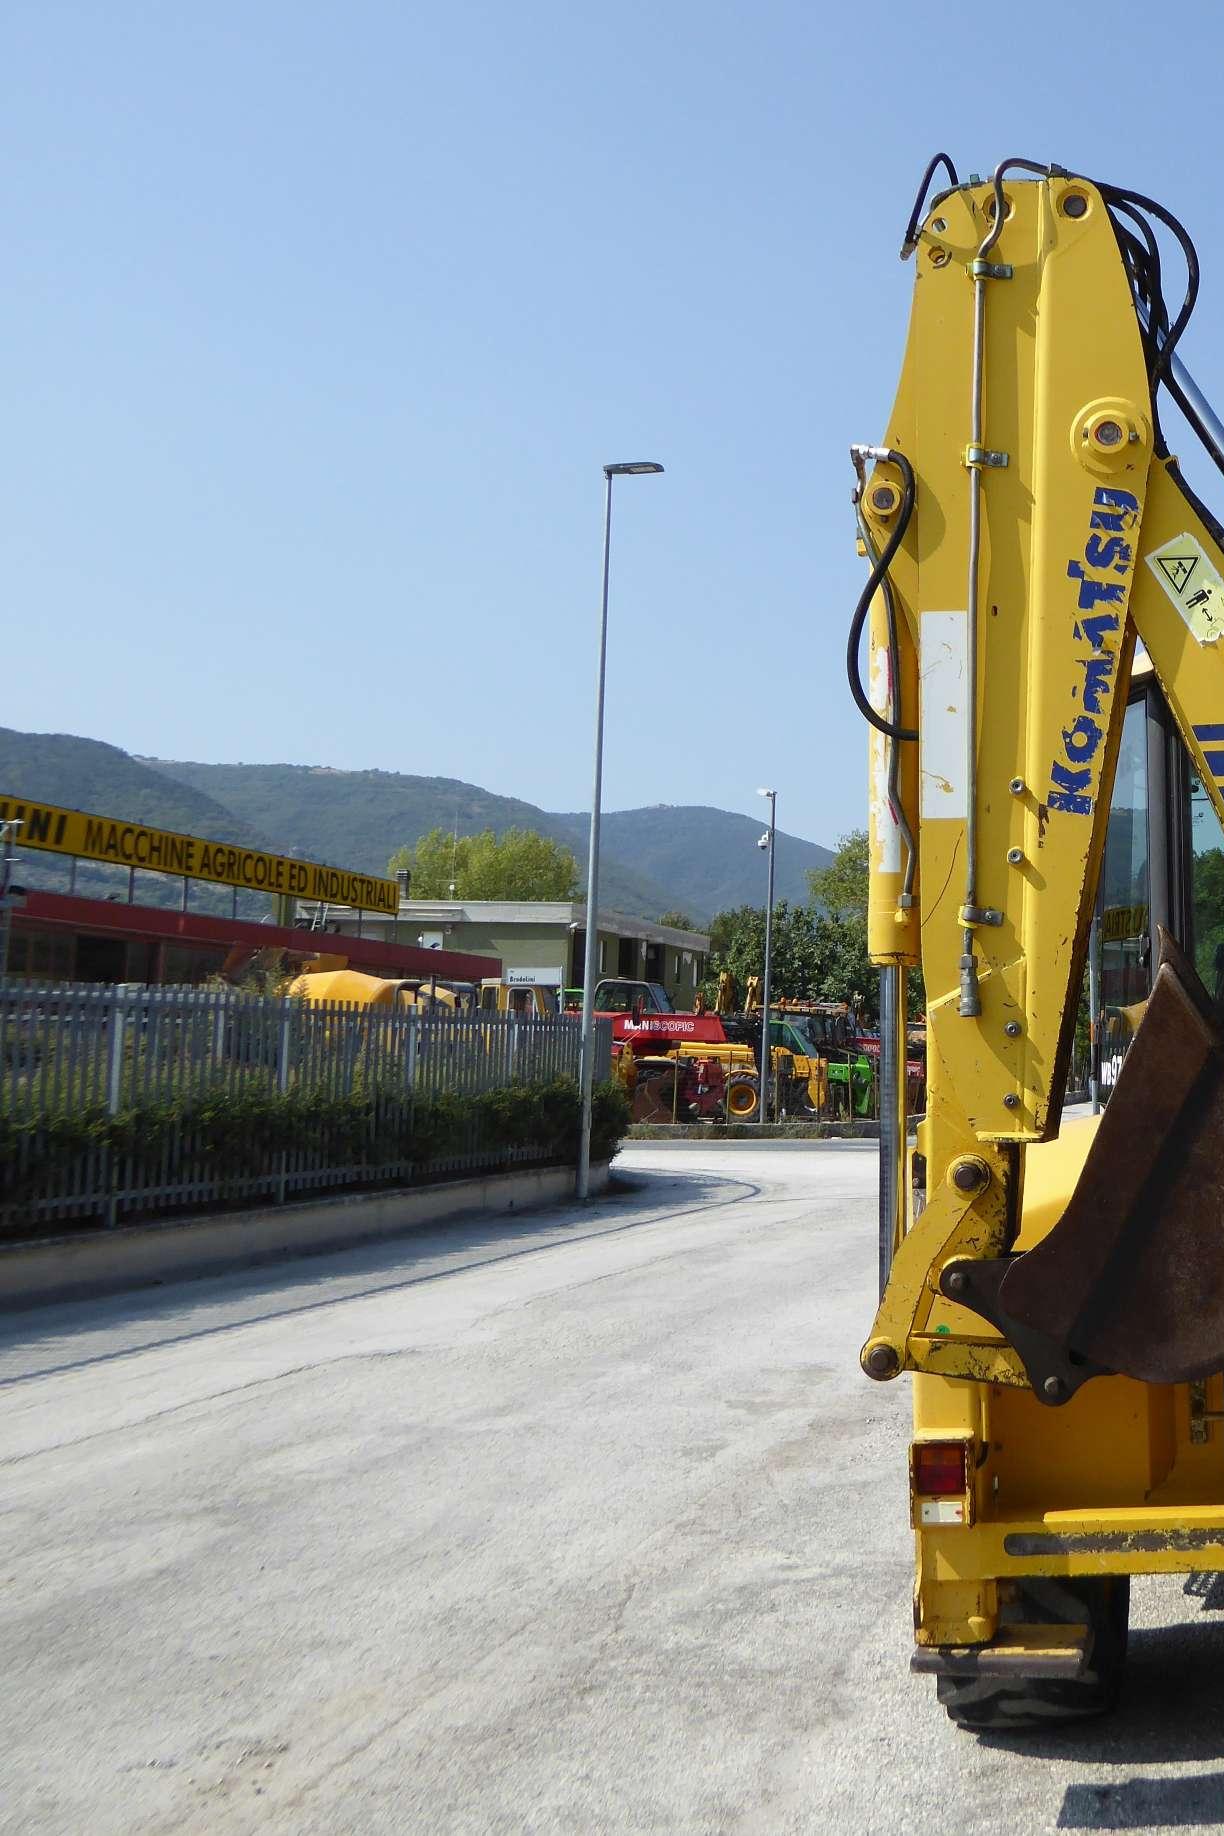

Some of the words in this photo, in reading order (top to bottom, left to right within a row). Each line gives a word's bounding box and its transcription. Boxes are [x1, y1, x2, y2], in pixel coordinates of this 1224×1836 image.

[84, 819, 195, 872] MACCHINE
[200, 845, 284, 889] AGRICOLE
[288, 863, 308, 893] ED
[313, 868, 397, 910] INDUSTRIALI
